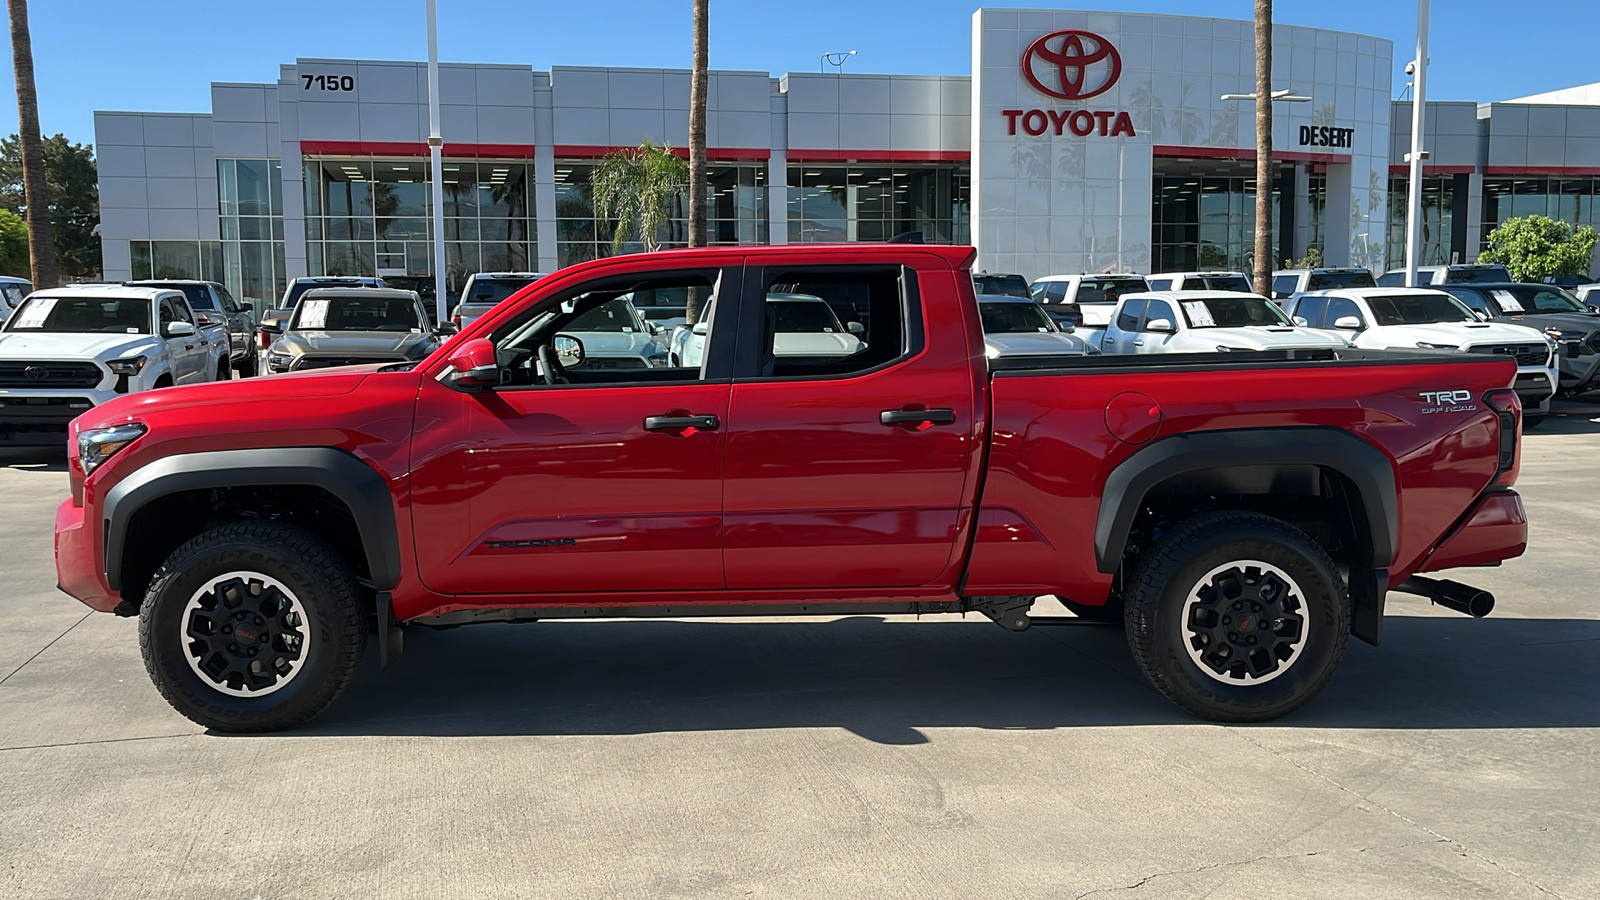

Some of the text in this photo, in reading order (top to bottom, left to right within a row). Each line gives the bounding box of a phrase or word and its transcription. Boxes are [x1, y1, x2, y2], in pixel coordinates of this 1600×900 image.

[301, 74, 354, 91] 7150
[1001, 109, 1136, 136] TOYOTA
[1299, 125, 1354, 148] DESERT
[1419, 389, 1473, 406] TRD
[483, 538, 577, 549] TACOMA
